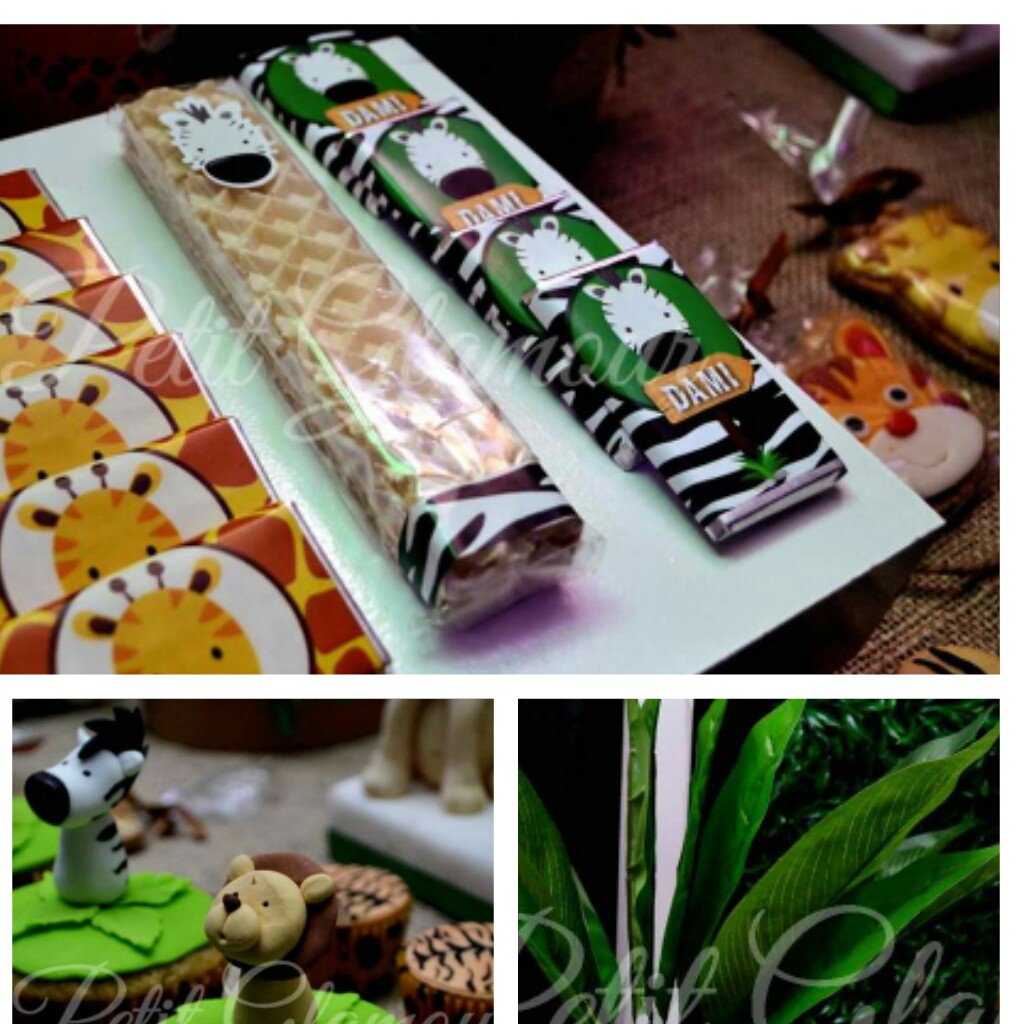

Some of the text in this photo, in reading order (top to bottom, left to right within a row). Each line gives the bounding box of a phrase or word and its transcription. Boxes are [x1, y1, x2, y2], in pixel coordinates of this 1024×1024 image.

[339, 95, 409, 133] DAMI
[457, 189, 527, 228] DAMI
[661, 361, 741, 413] DAMI
